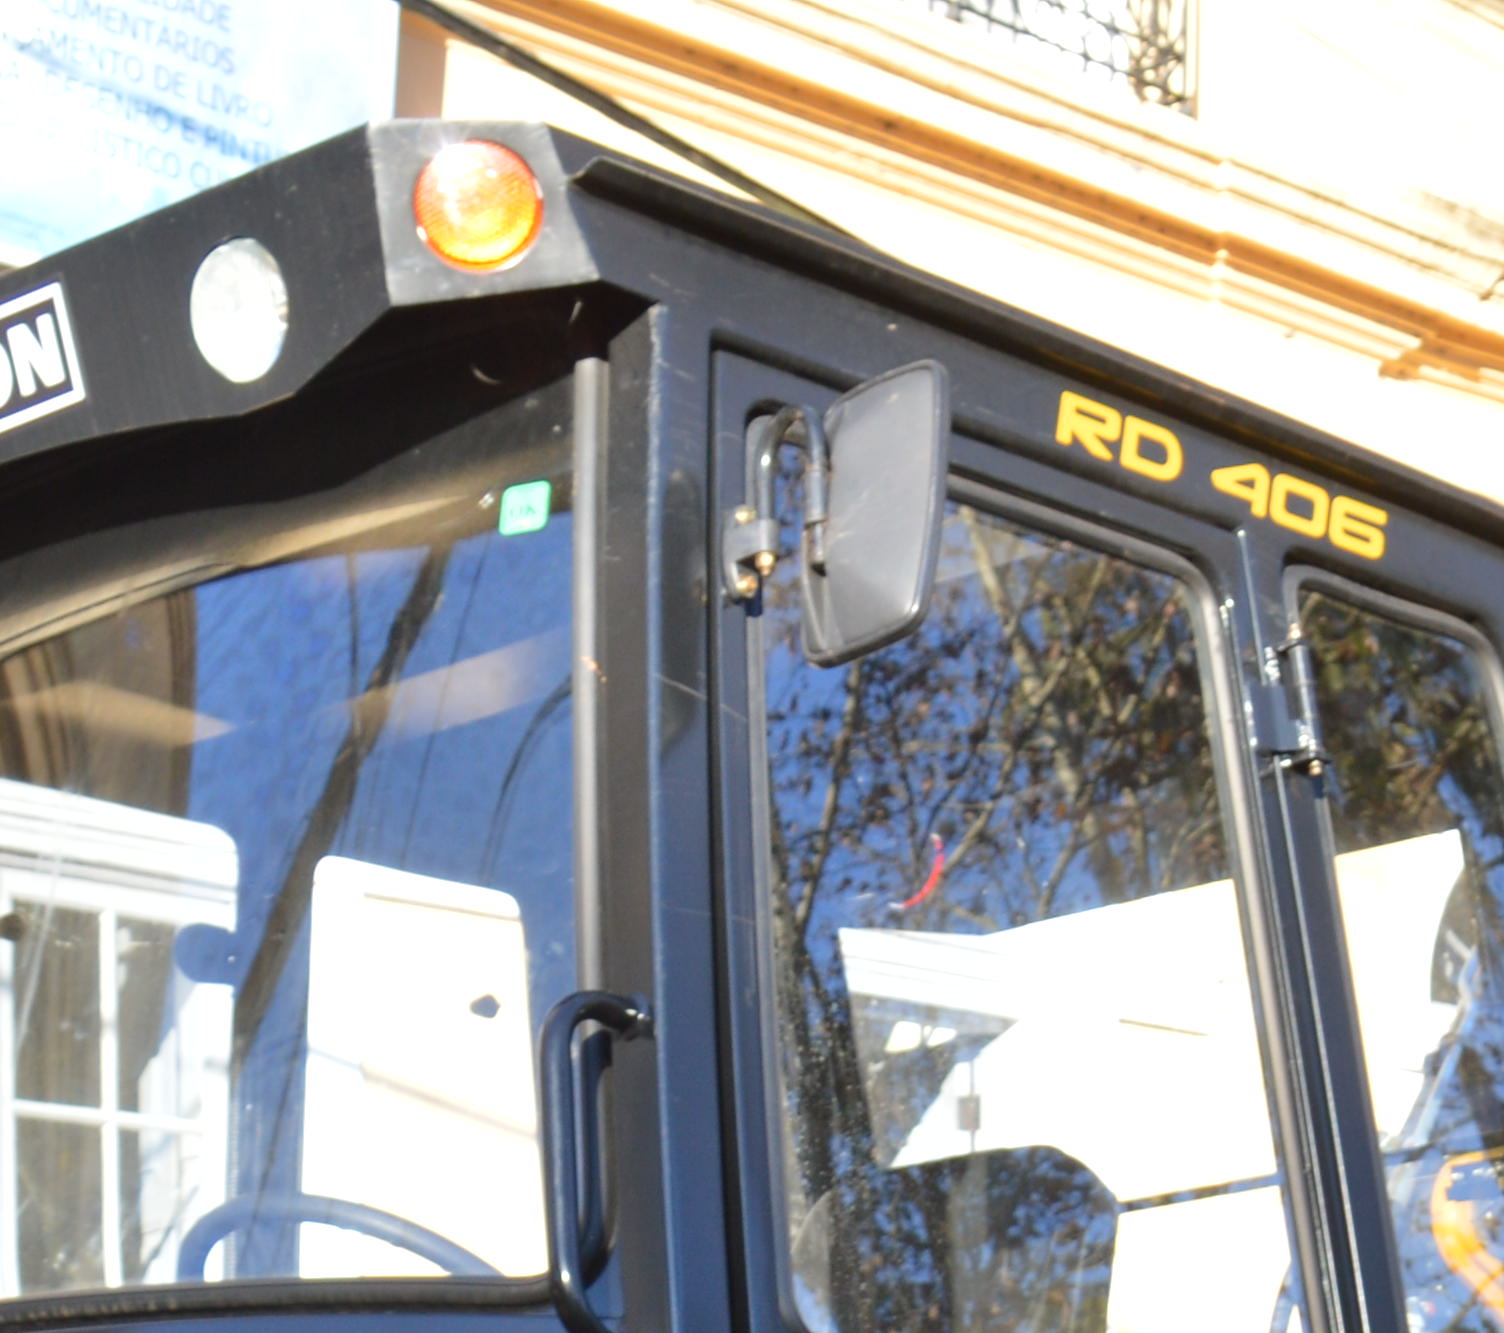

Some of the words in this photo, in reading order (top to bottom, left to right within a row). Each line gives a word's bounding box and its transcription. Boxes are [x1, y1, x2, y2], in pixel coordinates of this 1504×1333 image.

[154, 63, 188, 98] DE
[196, 80, 273, 127] LIVRO
[1056, 390, 1183, 482] RD
[1211, 463, 1388, 560] 406
